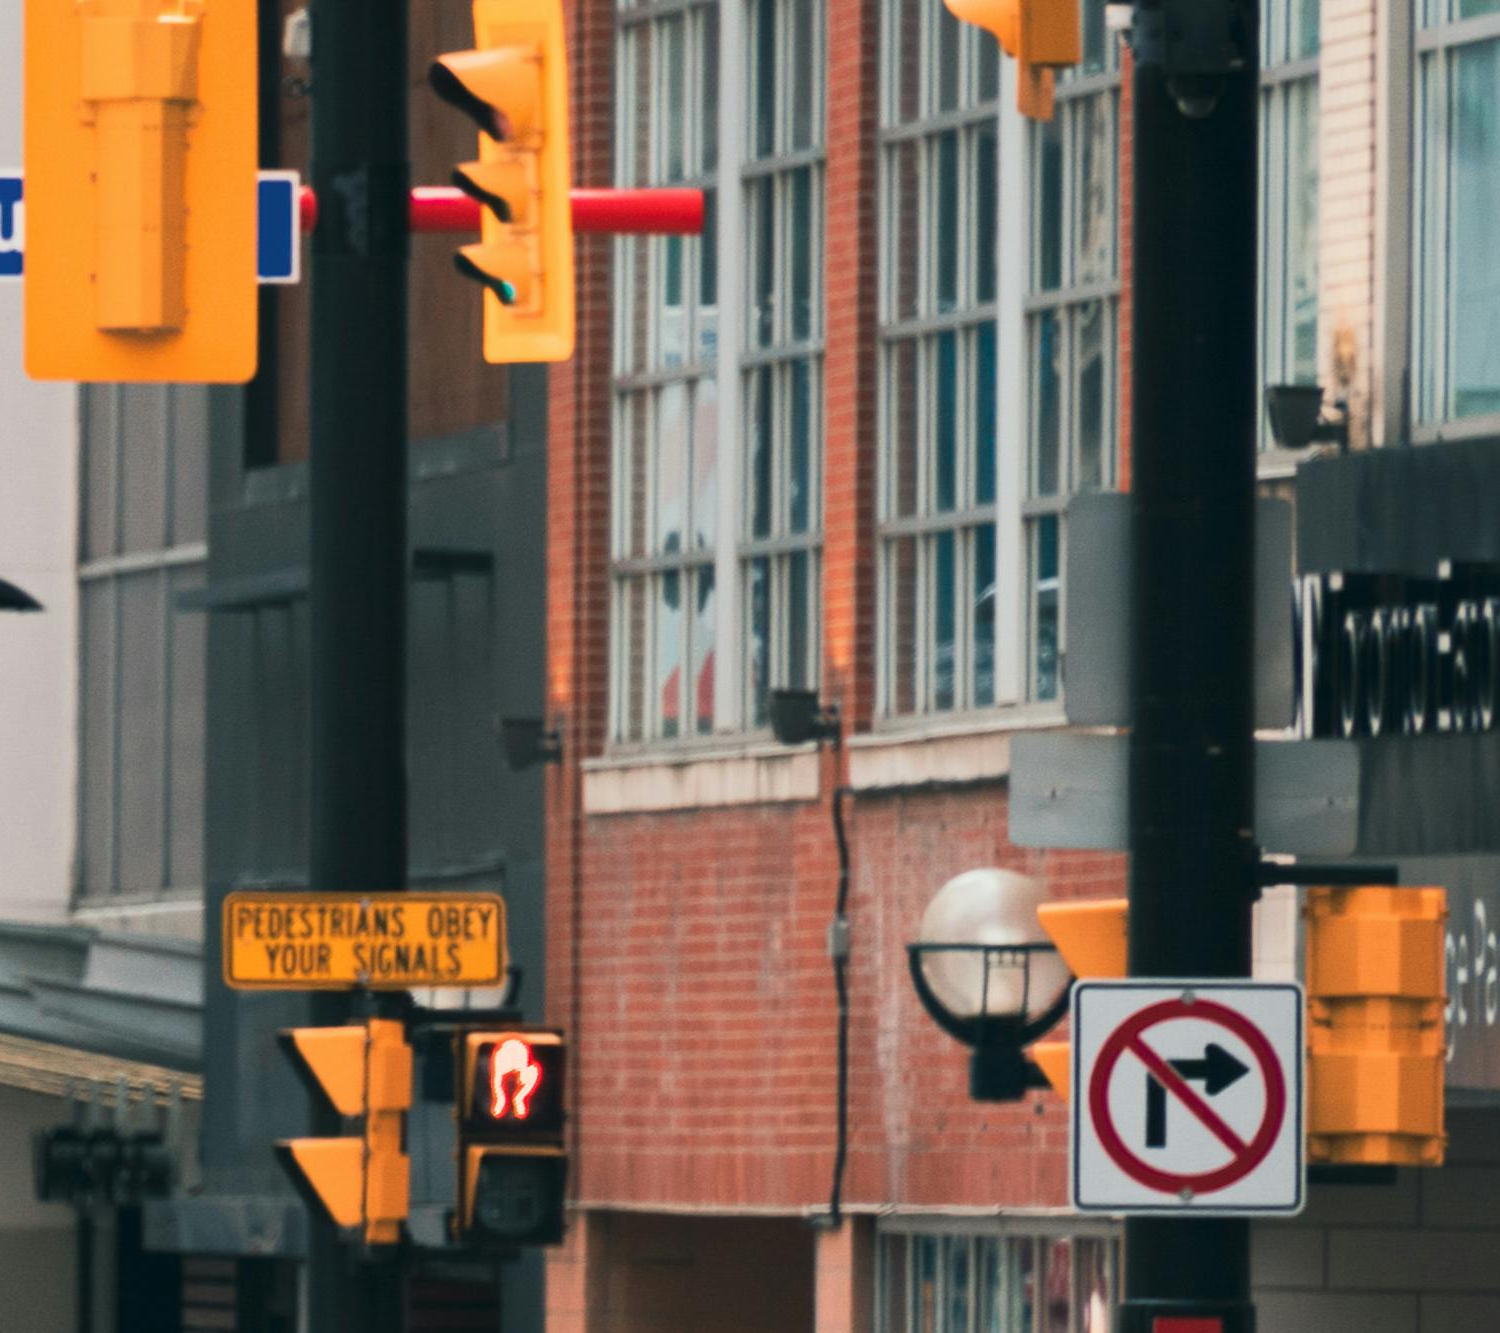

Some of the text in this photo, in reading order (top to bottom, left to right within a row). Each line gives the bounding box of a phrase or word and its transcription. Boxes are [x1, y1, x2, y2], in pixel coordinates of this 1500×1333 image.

[237, 905, 495, 941] PEDESTRIANS OBEY
[264, 942, 463, 978] YOUR SIGNALS
